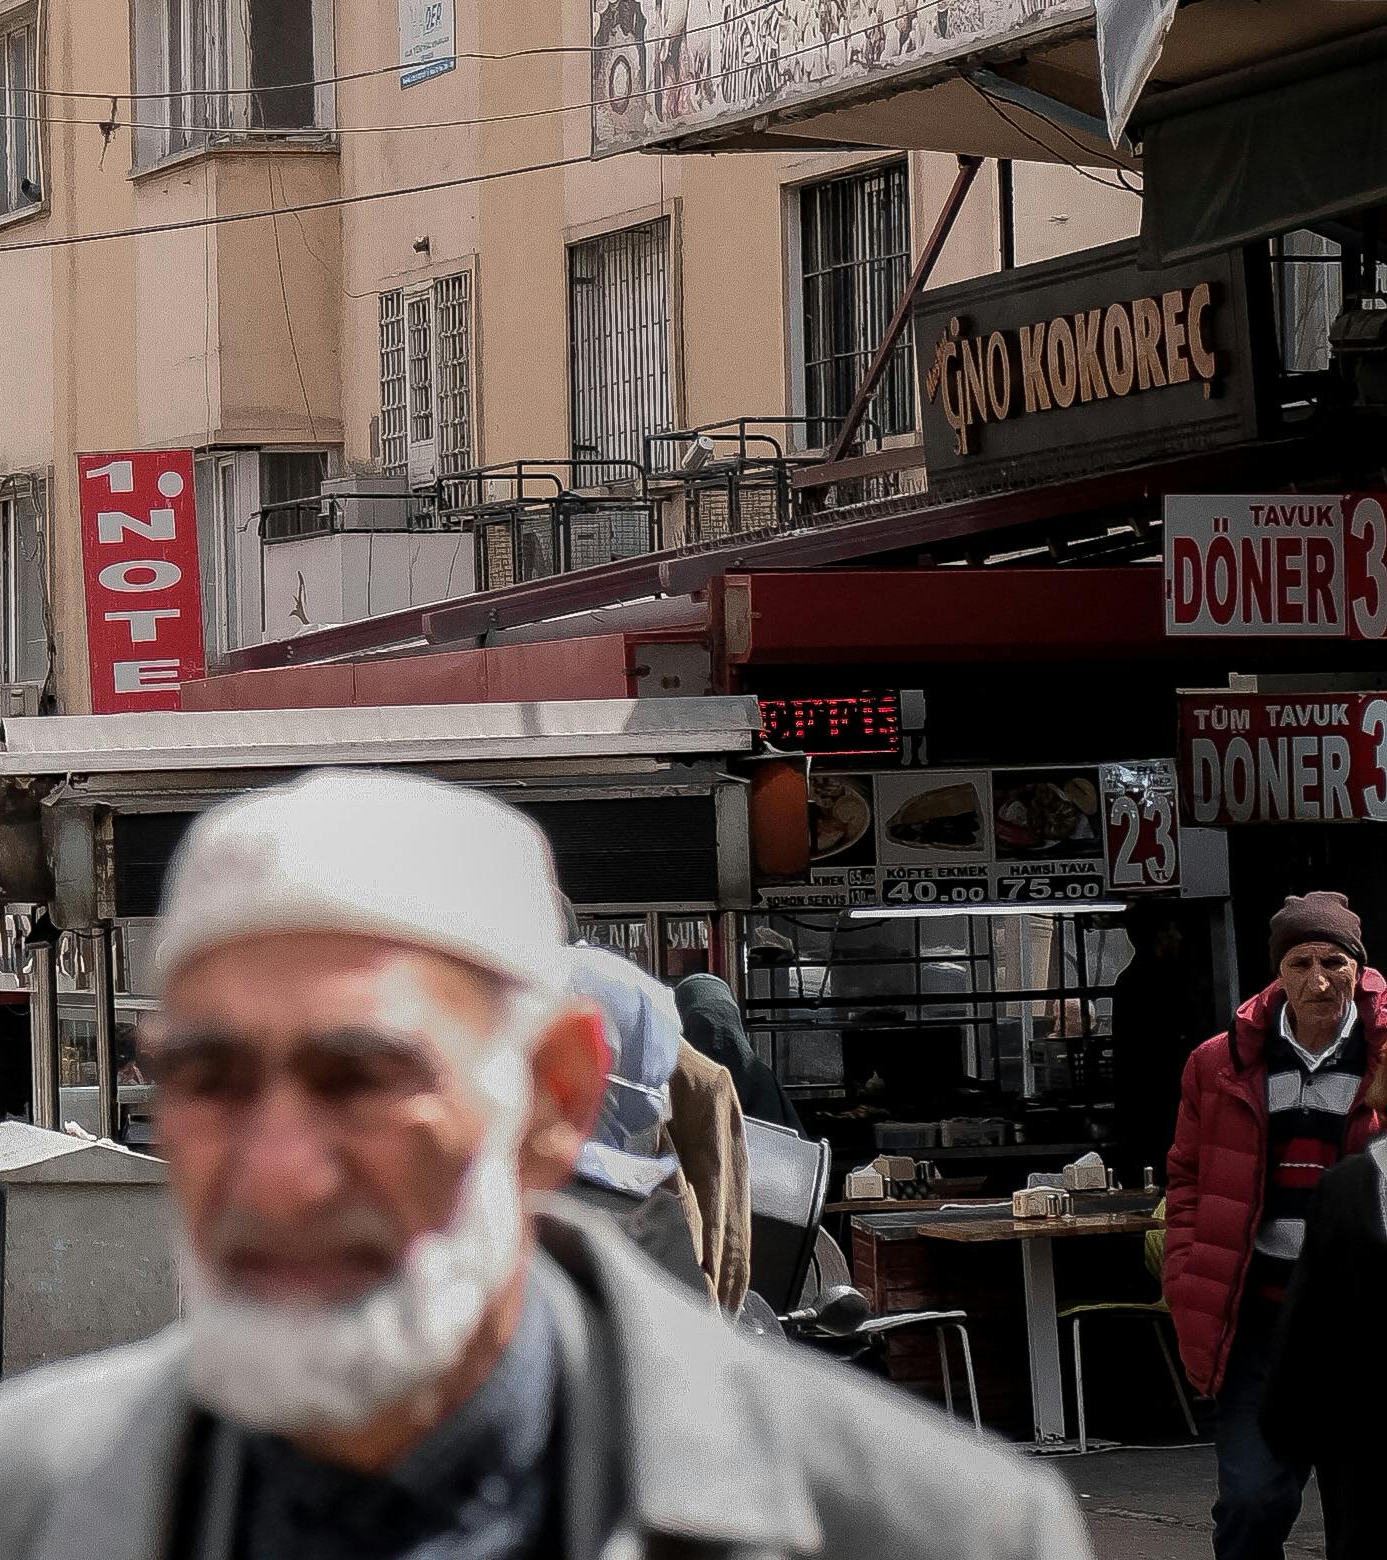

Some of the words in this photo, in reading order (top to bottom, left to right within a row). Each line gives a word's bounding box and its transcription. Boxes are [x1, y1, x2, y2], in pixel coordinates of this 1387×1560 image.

[1020, 282, 1216, 401] KOKOREÇ
[1249, 504, 1334, 528] TAVUK
[1173, 517, 1339, 625] DÖNER
[97, 508, 182, 694] NOTE
[1265, 703, 1350, 728] TAVUK
[937, 867, 989, 878] EKMEK
[1009, 864, 1057, 876] HAMSİ
[1060, 862, 1097, 875] TAVA
[887, 880, 985, 903] 40.00
